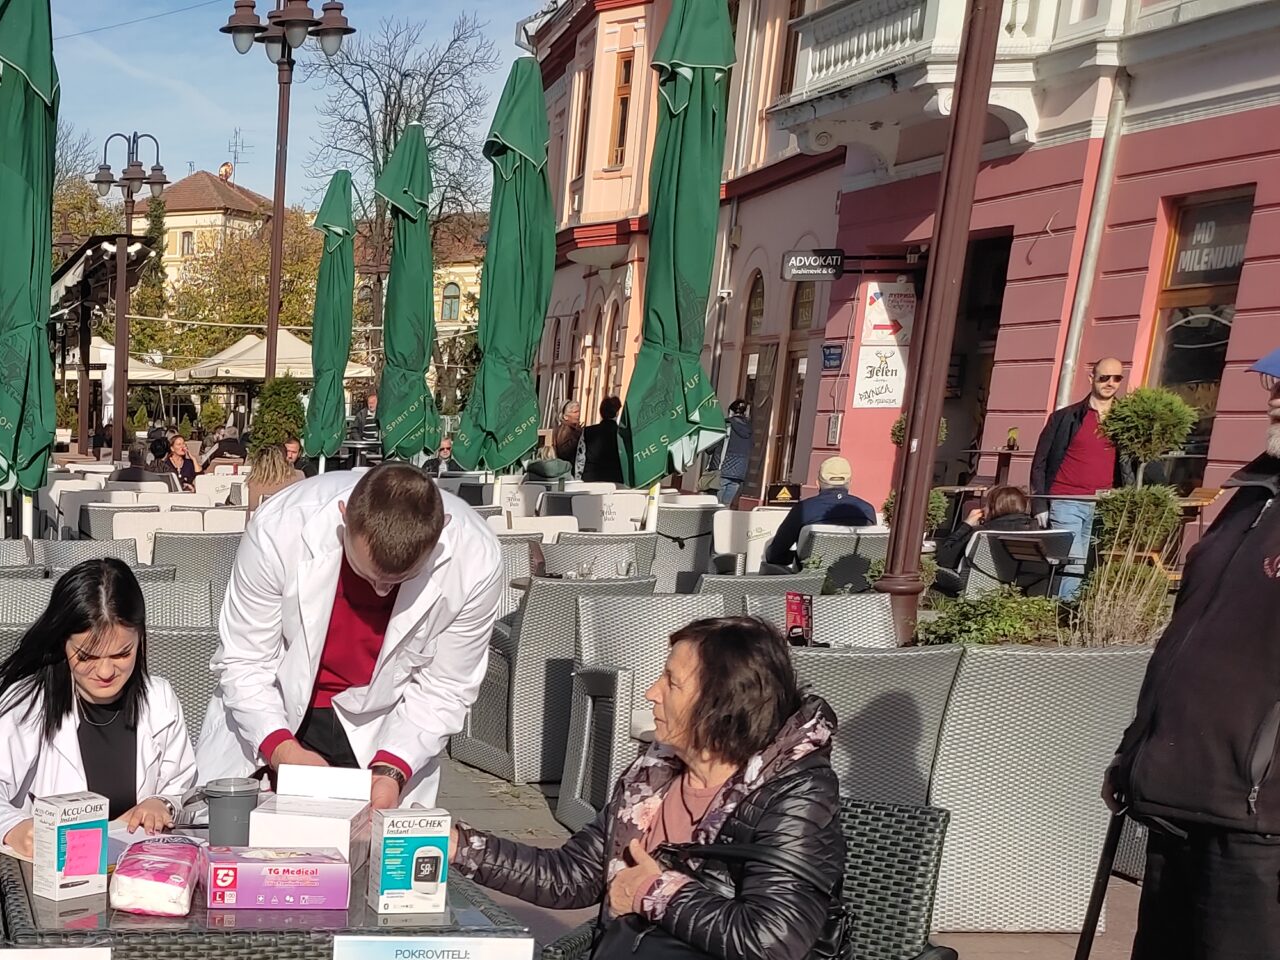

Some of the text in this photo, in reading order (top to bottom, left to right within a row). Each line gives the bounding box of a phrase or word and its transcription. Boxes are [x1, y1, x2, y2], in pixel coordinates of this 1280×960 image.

[1192, 221, 1216, 246] MD
[789, 256, 841, 266] ADVOKATI
[865, 366, 898, 379] Jelen
[386, 401, 420, 432] SPIRIT OF
[634, 443, 658, 462] THE
[61, 804, 104, 817] ACCU-CHEK
[387, 819, 443, 829] ACCU-CHEK
[395, 949, 470, 960] POKROVITELJ:
